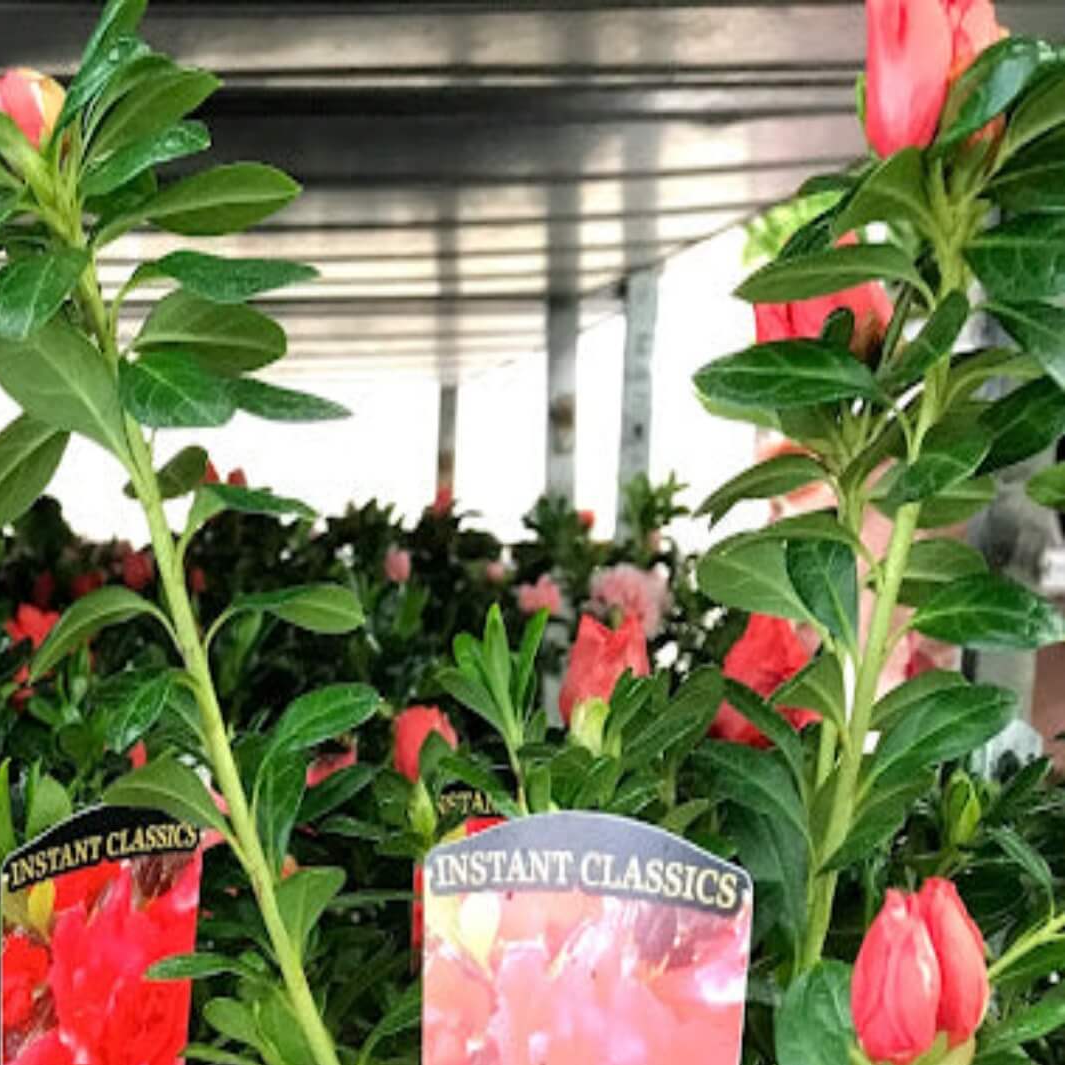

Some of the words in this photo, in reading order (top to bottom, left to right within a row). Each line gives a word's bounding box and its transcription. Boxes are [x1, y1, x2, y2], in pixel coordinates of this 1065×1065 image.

[11, 835, 101, 885] INSTANT
[106, 823, 197, 856] CLASSICS
[435, 849, 573, 886] INSTANT
[580, 852, 738, 908] CLASSICS
